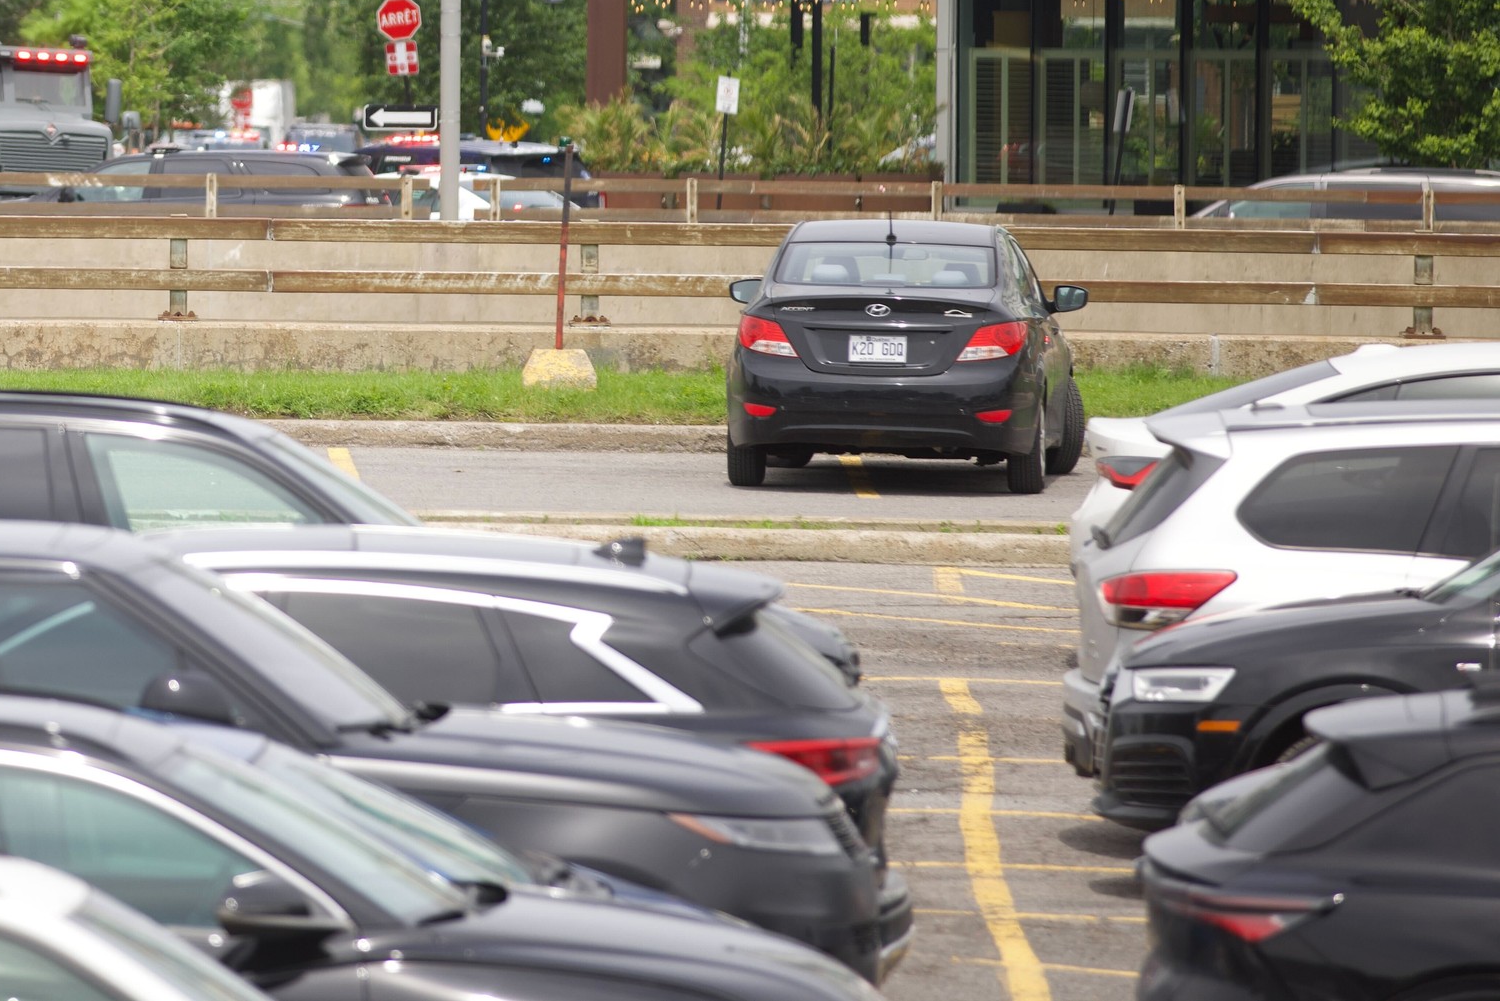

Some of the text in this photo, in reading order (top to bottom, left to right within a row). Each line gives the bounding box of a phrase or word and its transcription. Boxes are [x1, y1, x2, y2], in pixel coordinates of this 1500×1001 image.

[381, 8, 418, 28] ARRÊT
[852, 342, 904, 357] K20 GDQ
